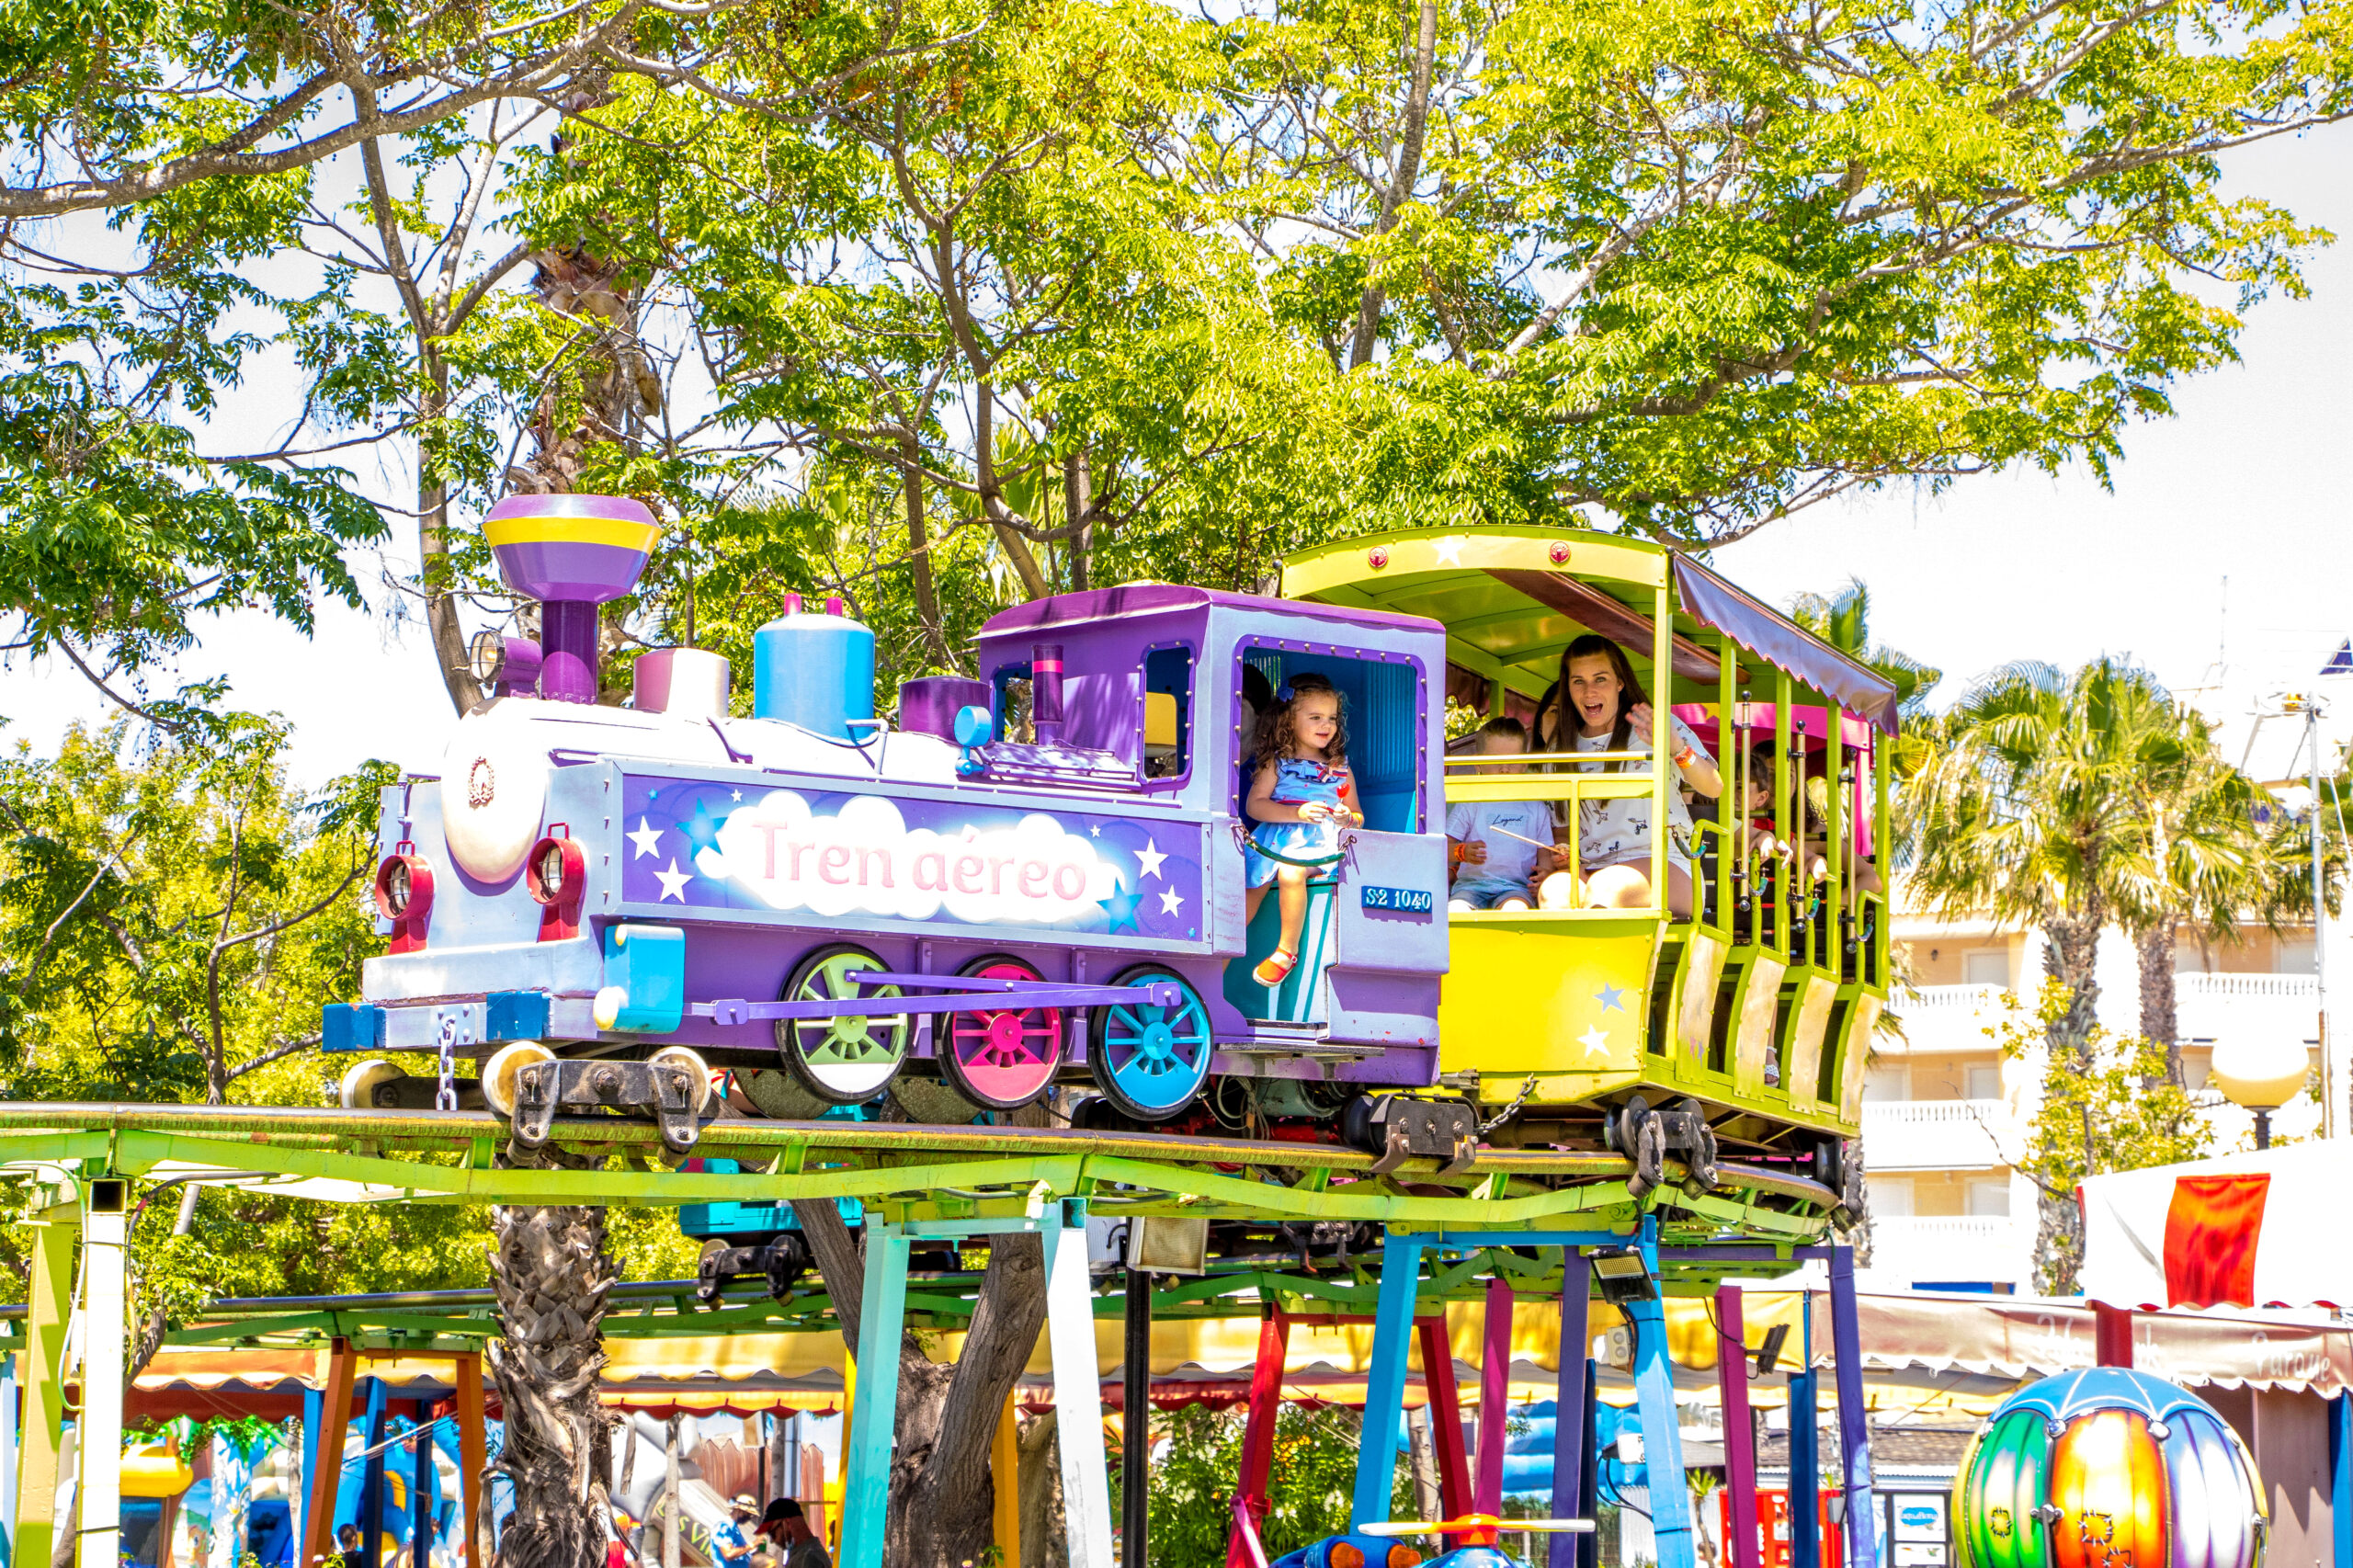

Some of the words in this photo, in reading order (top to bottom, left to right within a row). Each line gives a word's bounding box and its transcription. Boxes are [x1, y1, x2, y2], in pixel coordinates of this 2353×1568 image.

[1492, 814, 1524, 827] Legend
[751, 821, 895, 889] Tren
[912, 833, 1086, 901] aéreo
[1366, 888, 1388, 906] S2
[1394, 891, 1431, 909] 1040
